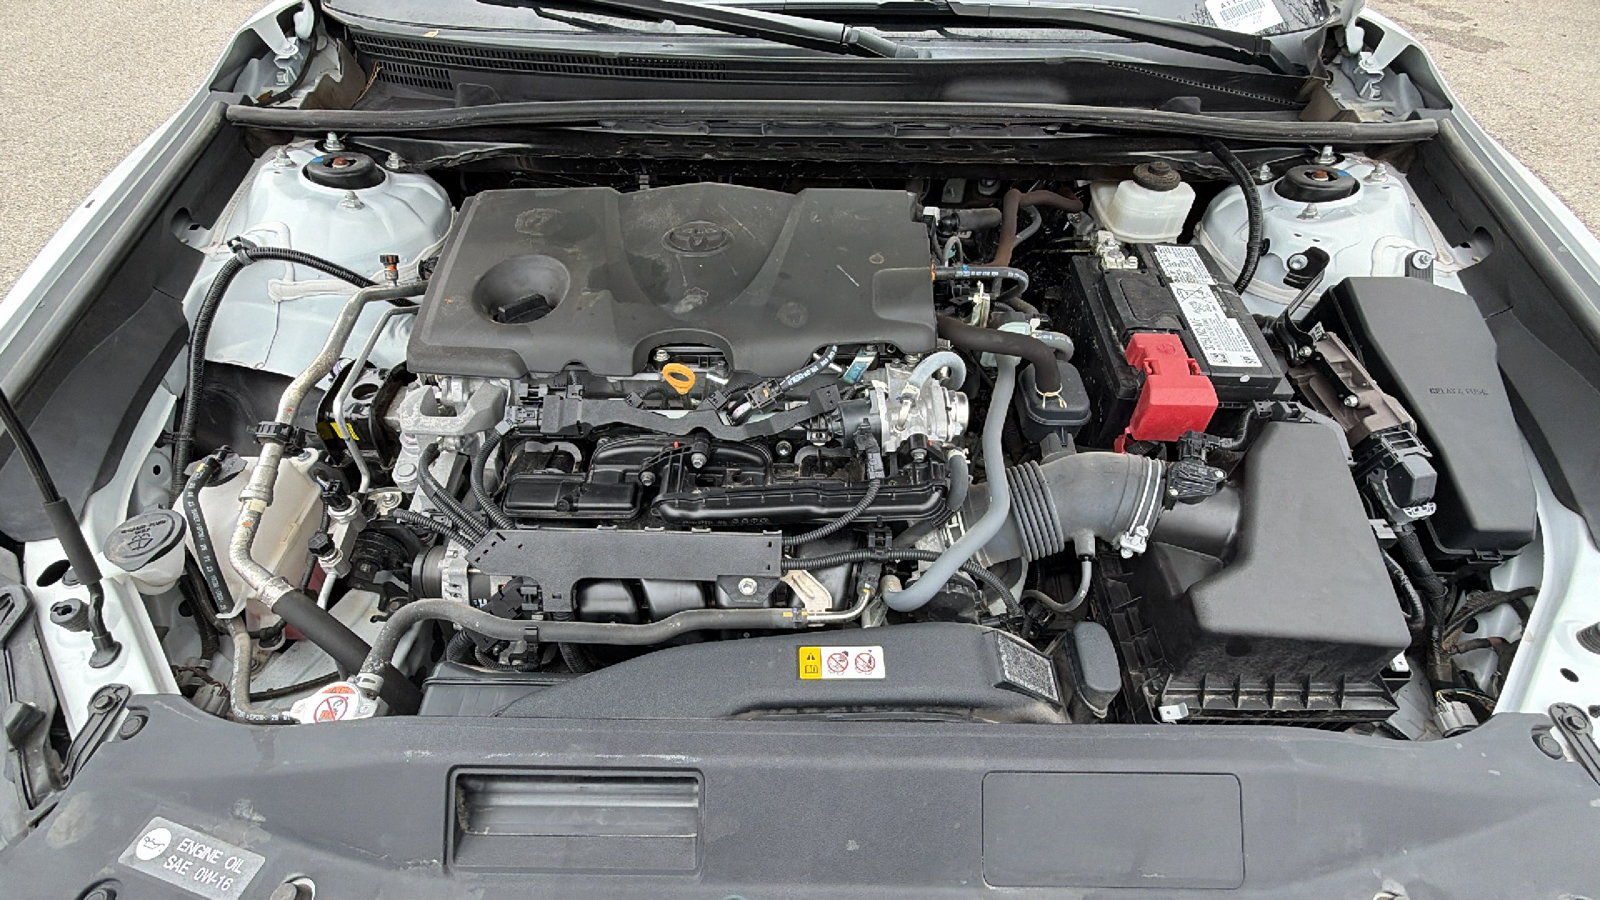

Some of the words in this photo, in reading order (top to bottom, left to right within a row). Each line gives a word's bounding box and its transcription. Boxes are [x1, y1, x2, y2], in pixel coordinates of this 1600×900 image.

[163, 855, 193, 875] SAE
[194, 868, 234, 891] 0W-16
[177, 838, 223, 864] ENGINE
[225, 857, 245, 874] OIL
